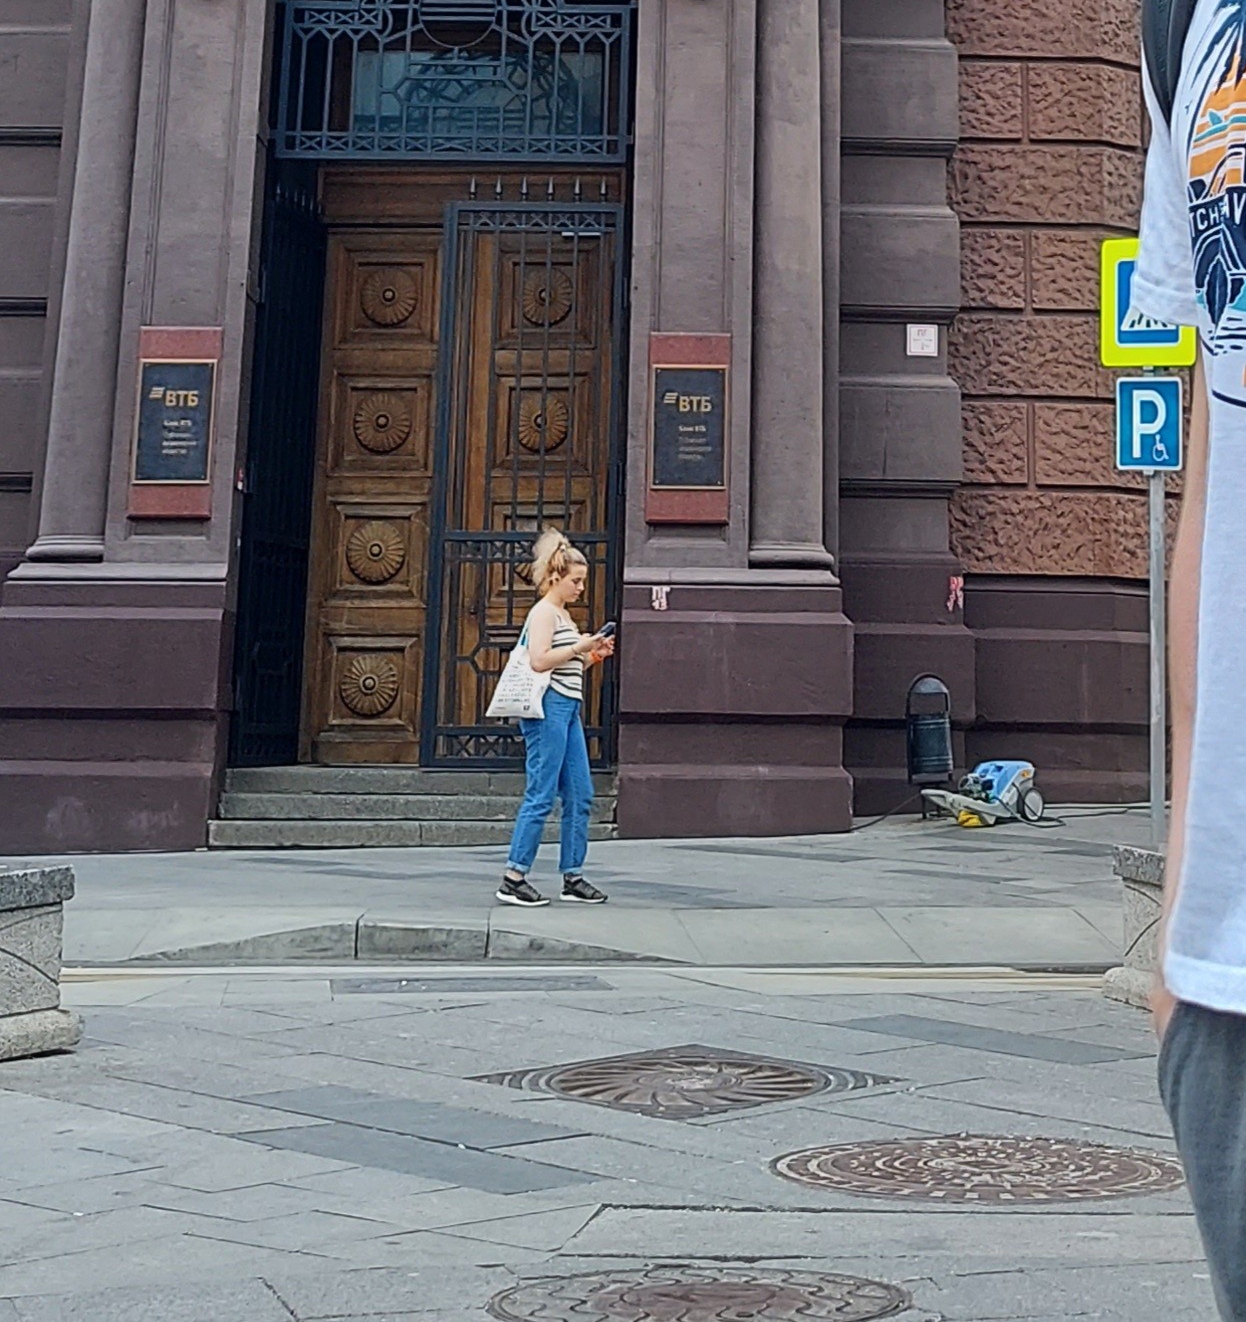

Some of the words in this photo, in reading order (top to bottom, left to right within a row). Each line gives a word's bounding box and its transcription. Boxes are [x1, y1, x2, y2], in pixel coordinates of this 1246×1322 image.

[165, 390, 200, 407] ВТБ
[679, 396, 713, 412] ВТБ
[1132, 389, 1168, 458] P
